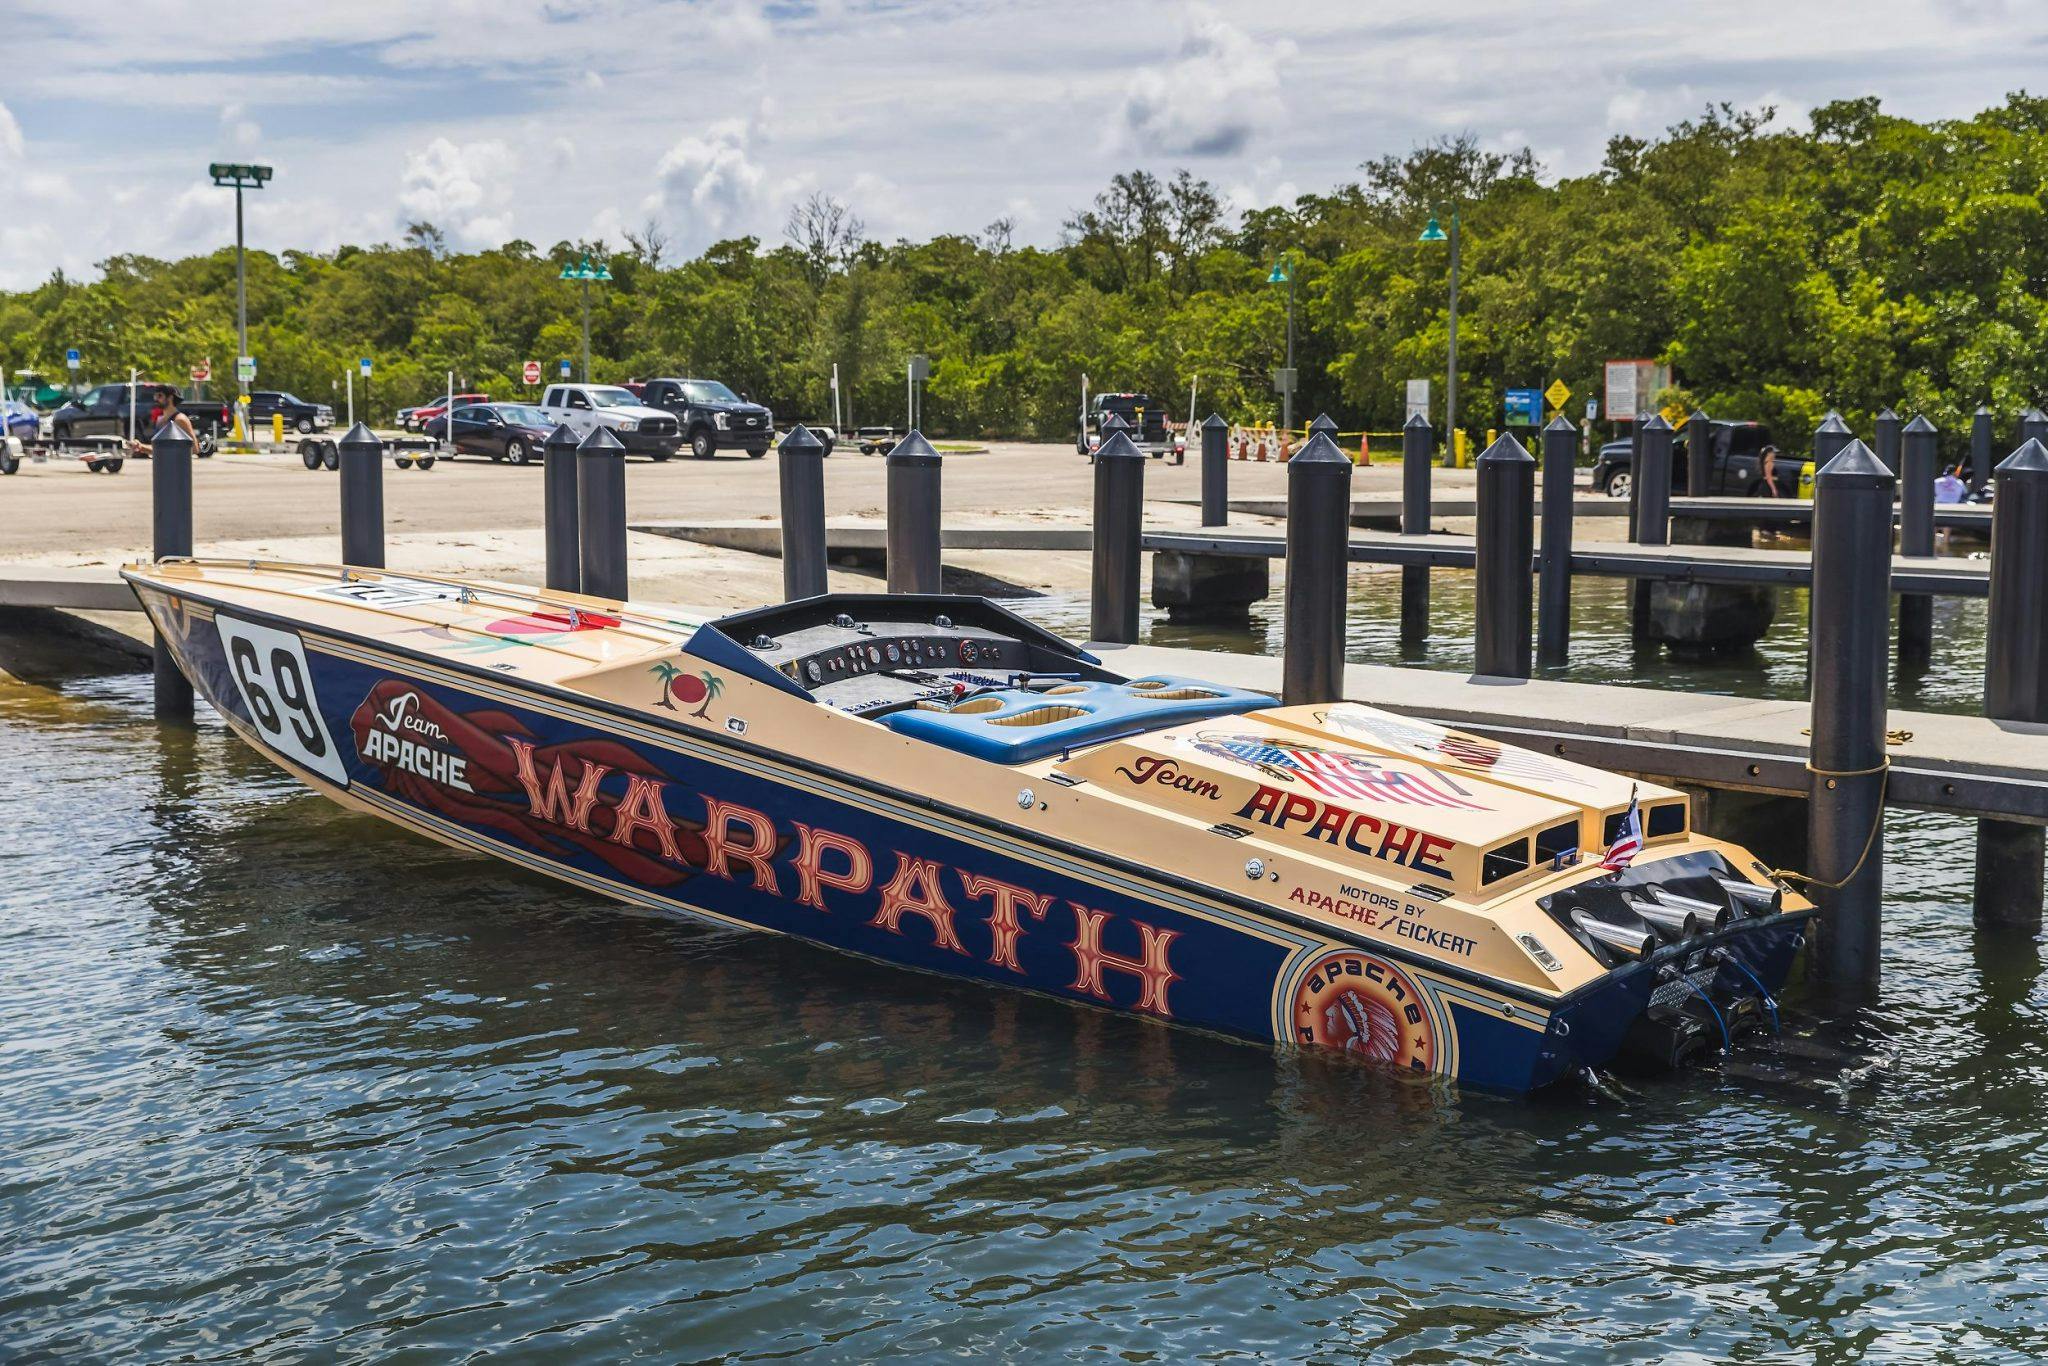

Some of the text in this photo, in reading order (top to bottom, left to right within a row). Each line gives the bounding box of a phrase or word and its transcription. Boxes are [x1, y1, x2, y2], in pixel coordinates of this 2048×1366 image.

[231, 635, 326, 758] 69
[376, 692, 448, 744] Team
[362, 728, 474, 793] APACHE
[1115, 756, 1456, 881] Team APACHE
[505, 736, 1181, 1016] WARPATH
[1340, 883, 1426, 918] MOTORS BY
